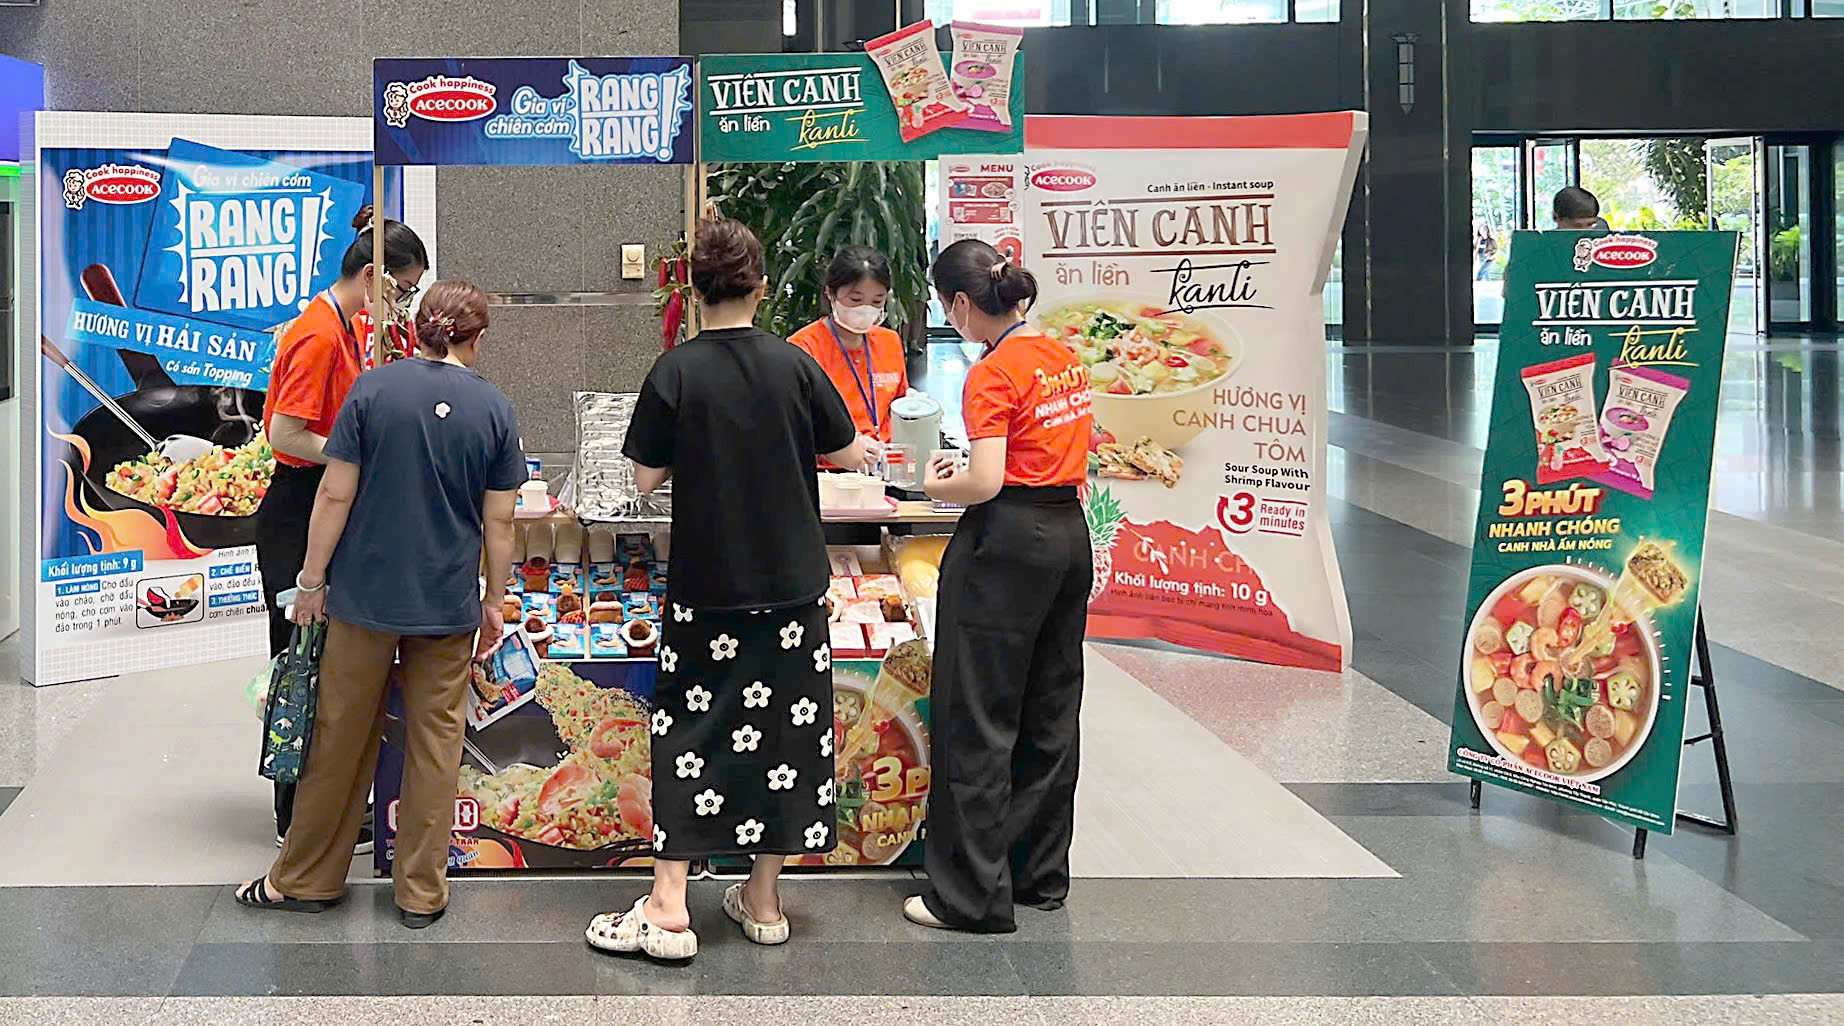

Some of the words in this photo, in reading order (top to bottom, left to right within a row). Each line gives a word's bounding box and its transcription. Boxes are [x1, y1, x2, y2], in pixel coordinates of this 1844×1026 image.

[409, 79, 437, 94] Cook
[440, 78, 494, 95] happiness
[581, 77, 658, 112] RANG
[709, 74, 775, 109] VIÊN
[783, 73, 862, 104] CANH
[515, 92, 547, 115] Gia
[551, 99, 569, 117] vị
[488, 117, 532, 135] chiên
[535, 120, 570, 135] cơm
[719, 116, 739, 133] ăn
[744, 114, 770, 132] liền
[85, 166, 109, 181] Cook
[112, 165, 159, 181] happiness
[192, 164, 220, 187] Gia
[281, 171, 311, 187] cơm
[980, 164, 1014, 173] MENU
[1147, 183, 1172, 194] Canh
[1213, 179, 1247, 191] Instant
[1250, 181, 1274, 193] soup
[189, 197, 297, 249] RANG
[1044, 200, 1141, 250] VIÊN
[1152, 203, 1275, 247] CANH
[1593, 236, 1614, 247] Cook
[1615, 236, 1656, 249] happiness
[1056, 263, 1083, 286] ăn
[1093, 260, 1130, 286] liền
[1536, 283, 1603, 320] VIÊN
[1608, 286, 1696, 319] CANH
[136, 323, 154, 346] VỊ
[1540, 327, 1560, 346] ăn
[1565, 326, 1592, 346] liền
[166, 360, 180, 373] Có
[203, 362, 253, 386] Topping
[1213, 386, 1283, 410] HƯƠNG
[1288, 394, 1306, 416] VỊ
[1173, 409, 1235, 430] CANH
[1242, 415, 1306, 436] CHUA
[1254, 439, 1306, 463] TÔM
[1225, 463, 1249, 475] Sour
[1251, 465, 1278, 478] Soup
[1281, 467, 1309, 479] With
[1225, 475, 1262, 488] Shrimp
[1265, 477, 1311, 491] Flavour
[1229, 491, 1257, 526] 3
[1260, 503, 1292, 518] Ready
[1295, 506, 1306, 517] in
[1260, 516, 1305, 532] minutes
[1488, 521, 1551, 539] NHANH
[1555, 515, 1621, 535] CHÓNG
[1498, 542, 1530, 552] CANH
[1531, 538, 1556, 552] NHÀ
[1557, 536, 1577, 550] ẤM
[1578, 537, 1612, 550] NÓNG
[48, 561, 69, 577] Khối
[72, 562, 98, 577] lượng
[123, 557, 129, 569] 9
[131, 559, 137, 570] g
[102, 580, 117, 590] Cho
[1115, 571, 1146, 587] Khối
[1150, 575, 1190, 596] lượng
[1194, 582, 1226, 598] tịnh:
[1231, 583, 1251, 600] 10
[1256, 590, 1268, 606] g
[56, 599, 69, 608] vào
[82, 608, 95, 617] cho
[120, 603, 133, 612] vào
[73, 620, 93, 631] trong
[1457, 747, 1479, 761] CÔNG
[1526, 767, 1561, 783] ACECOOK
[1581, 784, 1601, 793] NAM
